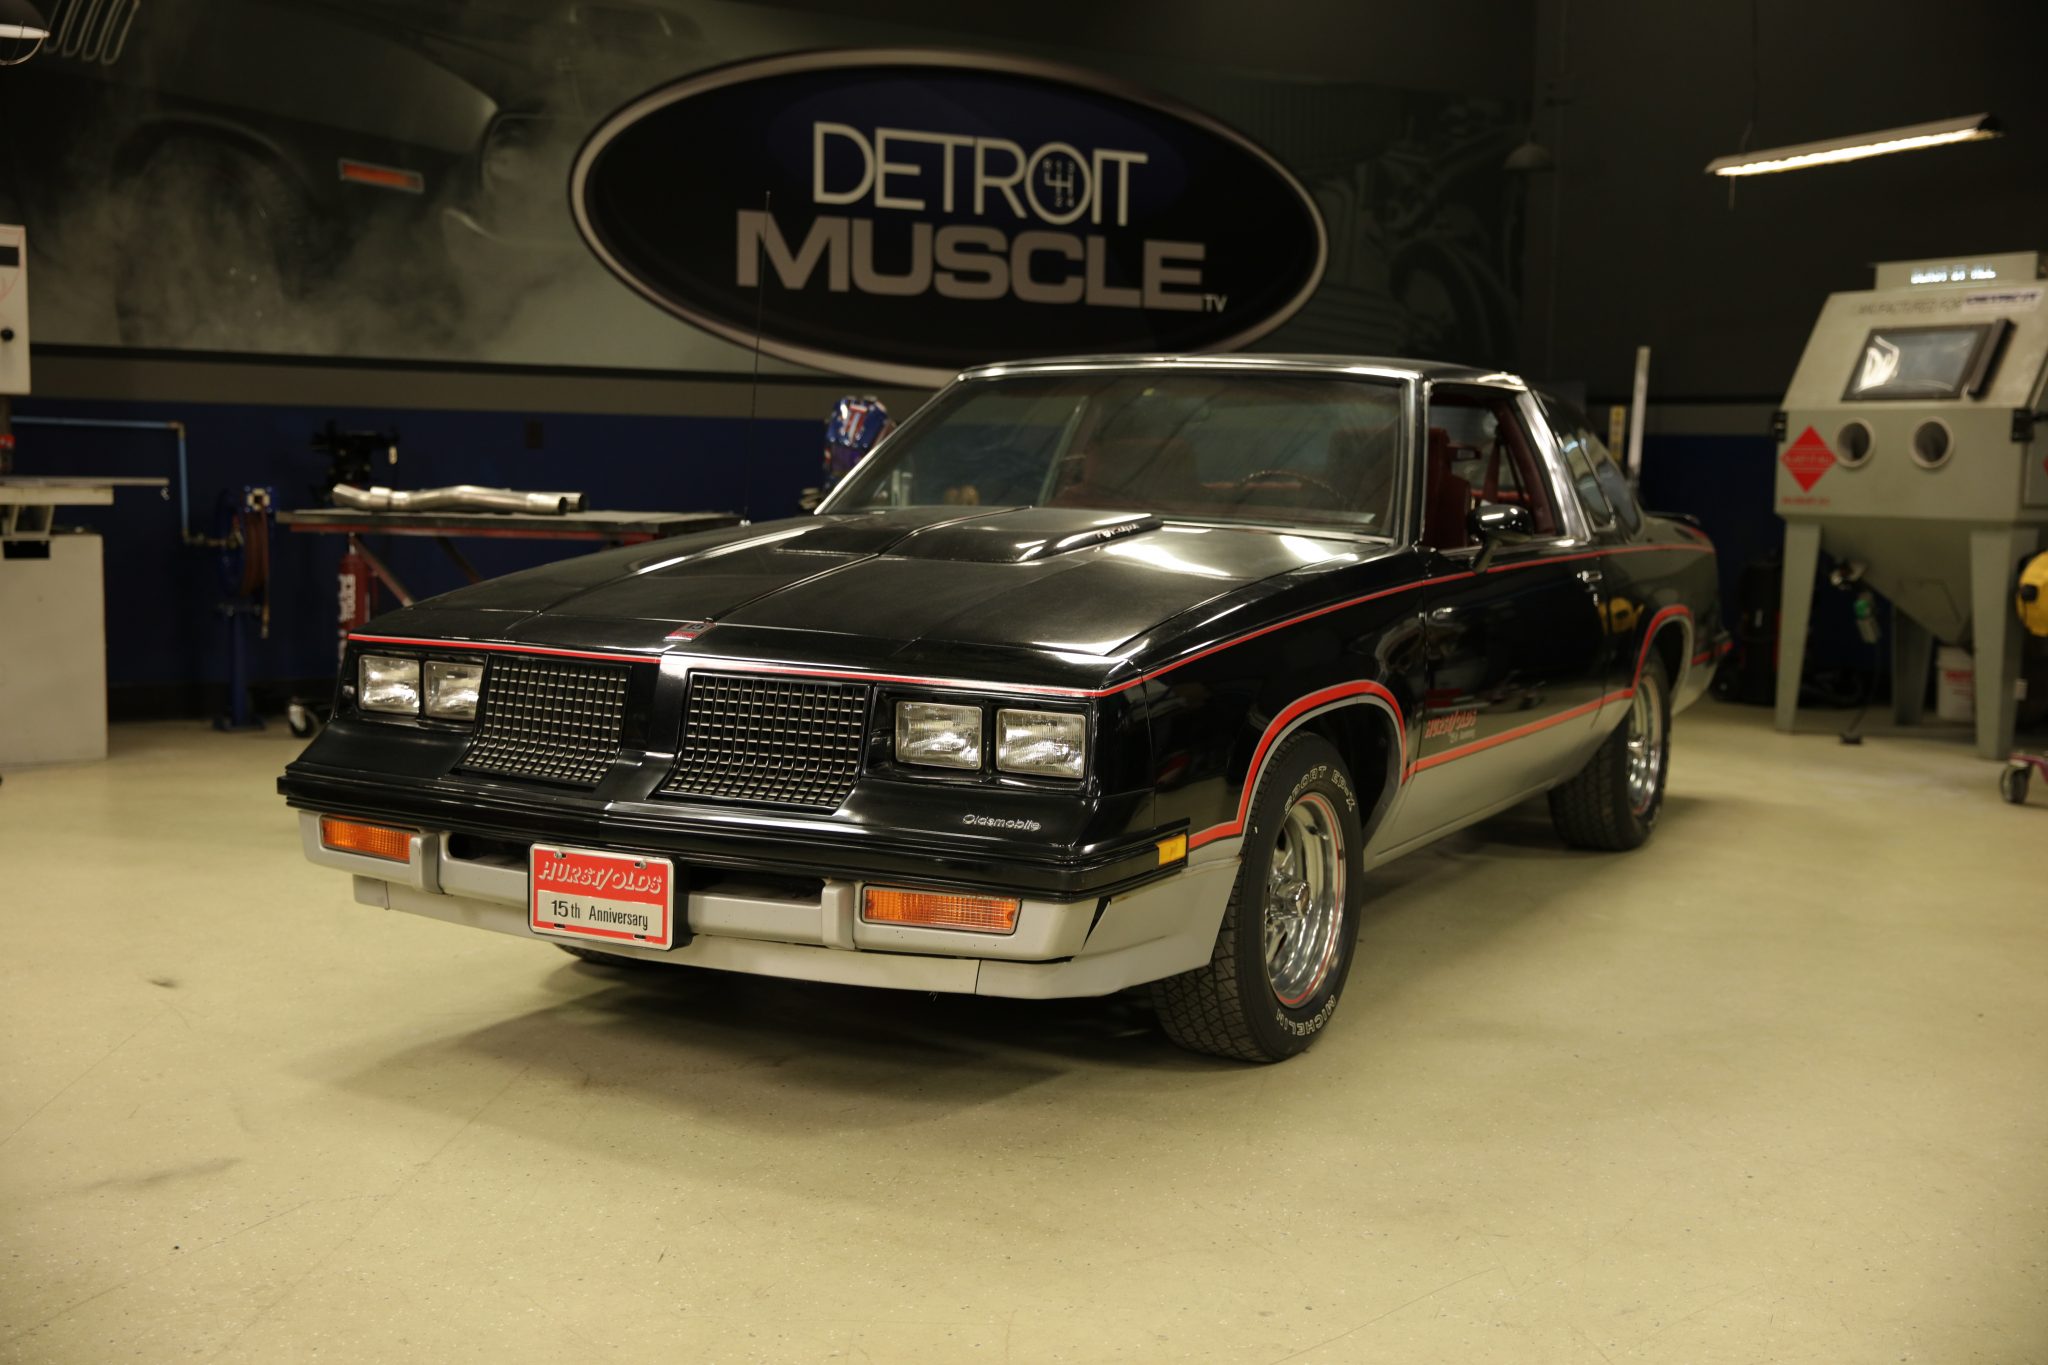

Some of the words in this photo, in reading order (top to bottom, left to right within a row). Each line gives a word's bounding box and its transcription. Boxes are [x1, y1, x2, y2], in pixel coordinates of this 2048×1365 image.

[813, 121, 1149, 227] DETROIT
[736, 208, 1207, 313] MUSCLE
[1203, 293, 1229, 314] TV
[962, 813, 1042, 832] Oldsmobile
[538, 860, 663, 895] HURST/OLDS
[551, 899, 581, 919] 15th
[588, 904, 649, 931] Anniversary
[1275, 993, 1337, 1036] MICHELIN
